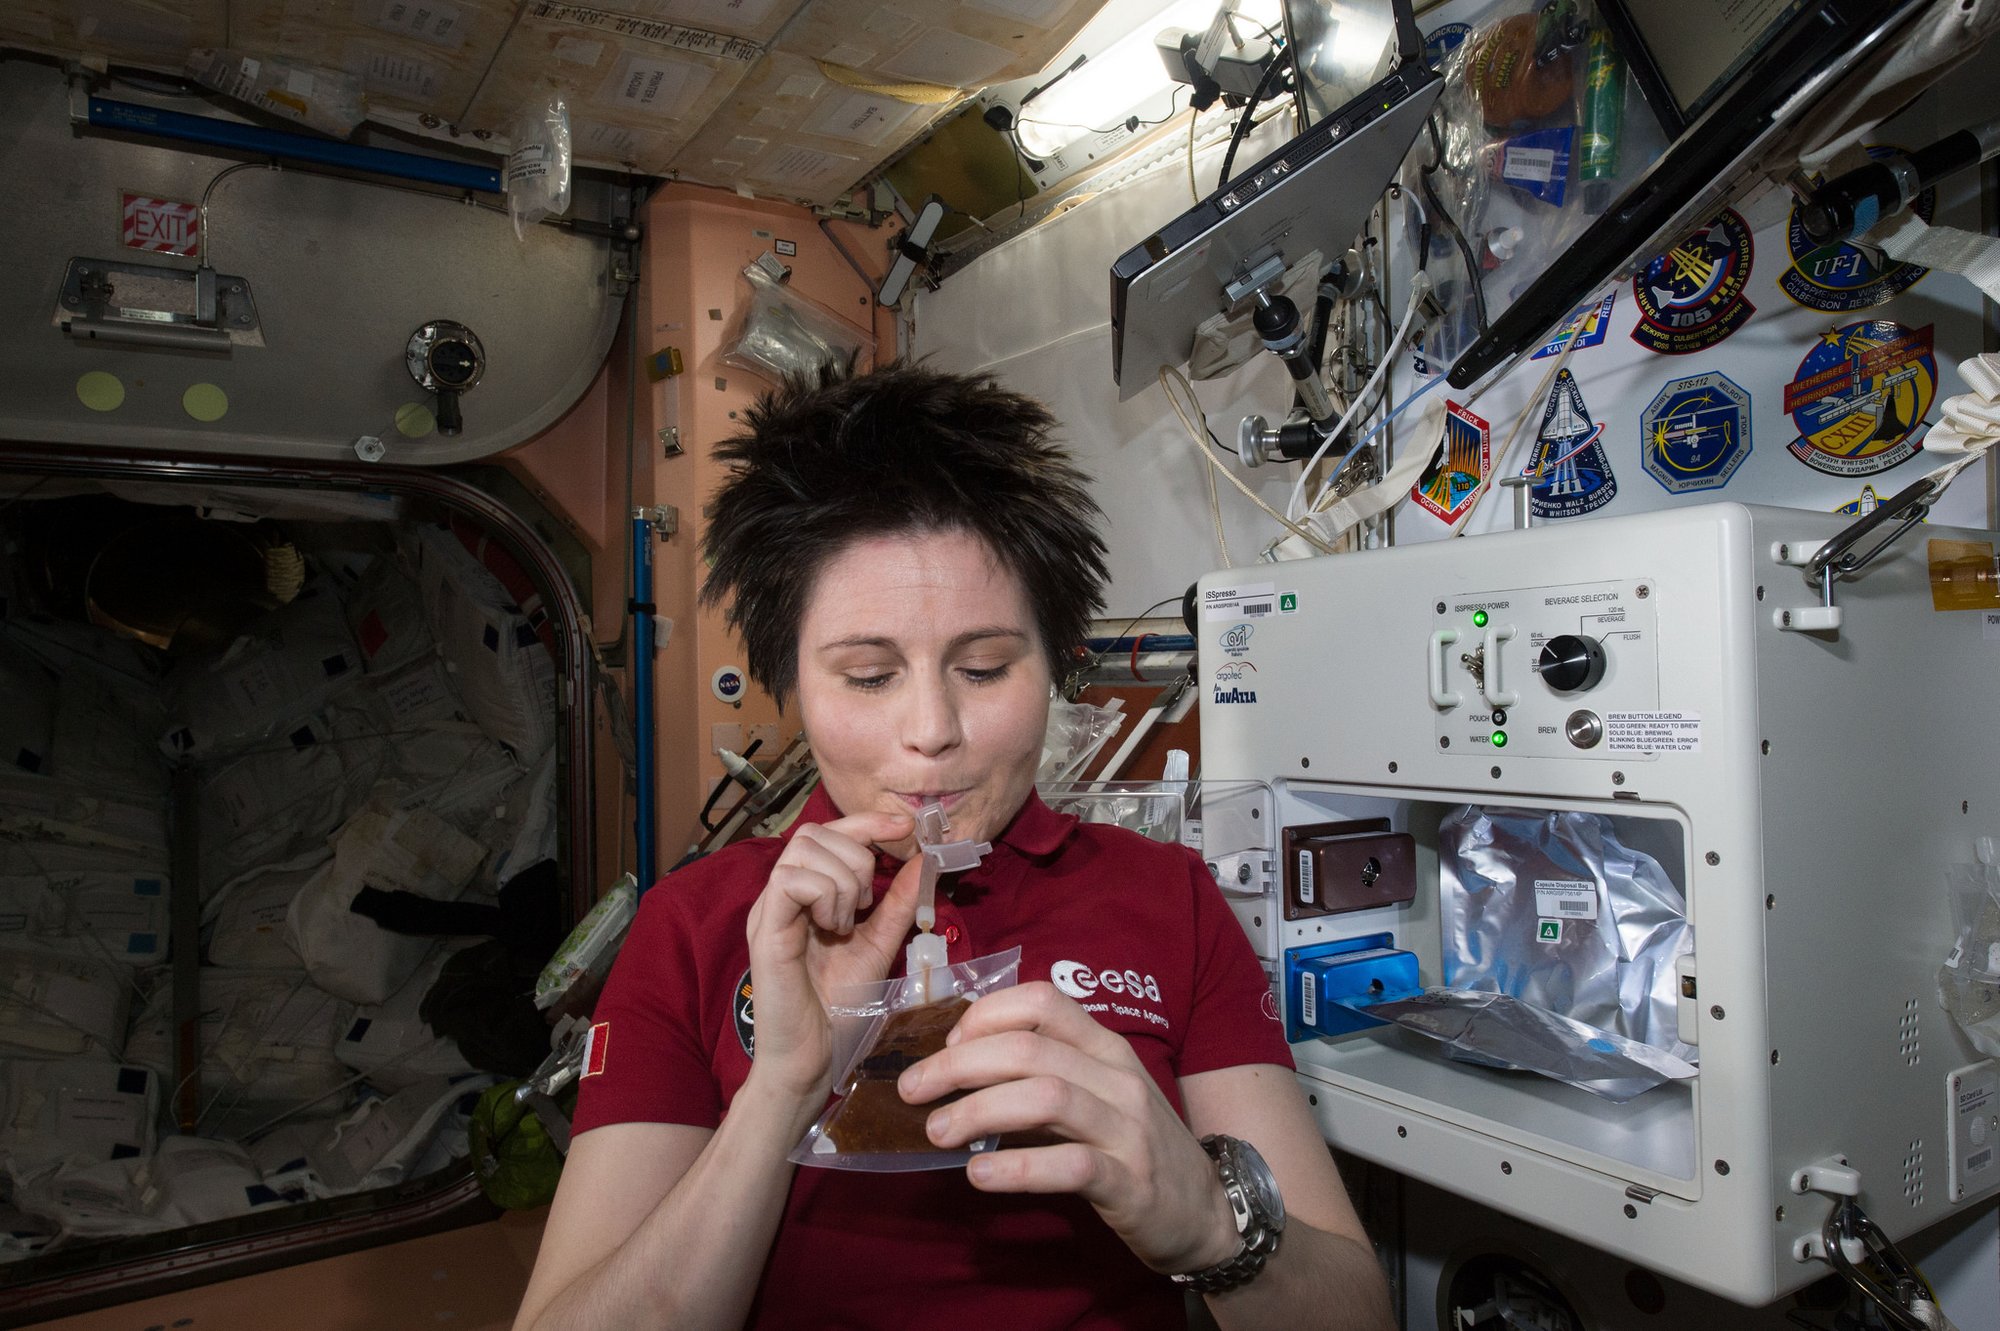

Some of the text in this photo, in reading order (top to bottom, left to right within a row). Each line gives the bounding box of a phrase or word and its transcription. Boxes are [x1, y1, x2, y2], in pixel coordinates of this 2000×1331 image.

[1425, 24, 1462, 47] TURCKOW
[136, 209, 186, 241] EXIT
[1729, 232, 1749, 297] FORRESTER
[1813, 252, 1862, 278] UF-1
[1636, 287, 1656, 317] BARRY
[1786, 282, 1841, 310] CULBERTSON
[1671, 306, 1713, 327] 105
[1673, 324, 1718, 342] CULBERTSON
[1706, 326, 1730, 343] HELMS
[1546, 338, 1586, 354] KAVDI
[1653, 340, 1670, 350] VOSS
[1677, 377, 1709, 391] STS-112
[1792, 365, 1844, 393] WETHERBEE
[1545, 379, 1562, 418] COCKRELL
[1566, 377, 1585, 413] LOCKHART
[1719, 381, 1744, 401] MELROY
[1791, 381, 1846, 407] HERRINGTON
[1650, 393, 1671, 415] ASHBY
[1457, 409, 1479, 426] FRICK
[1820, 415, 1876, 450] CXIII
[1530, 441, 1542, 467] PERRIN
[1592, 441, 1613, 480] CHANG-DIAZ
[1690, 454, 1701, 464] 9A
[1720, 447, 1745, 479] SELLERS
[1813, 451, 1839, 465] КОРЗУН
[1882, 450, 1910, 467] PETTIT
[1808, 456, 1844, 473] BOWERSOX
[1650, 464, 1674, 486] MAGNUS
[1457, 483, 1470, 491] 110
[1549, 478, 1584, 496] 111
[1588, 480, 1614, 501] BURSCH
[1420, 497, 1442, 515] OCHOA
[1549, 507, 1581, 517] WHITSON
[1565, 498, 1584, 509] WALZ
[1206, 590, 1236, 600] ISSpresso
[1545, 593, 1618, 605] BEVERAGE SELECTION
[1455, 602, 1509, 612] ISSPRESSO POWER
[719, 678, 740, 689] NASA
[1216, 672, 1242, 681] argotec
[1215, 687, 1257, 704] LAVAZZA
[1469, 714, 1490, 722] POUCH
[1538, 726, 1558, 734] BREW
[1100, 969, 1162, 1003] esa
[1111, 1002, 1141, 1018] Space
[1143, 1009, 1169, 1029] Agency
[1960, 1095, 1966, 1103] SD
